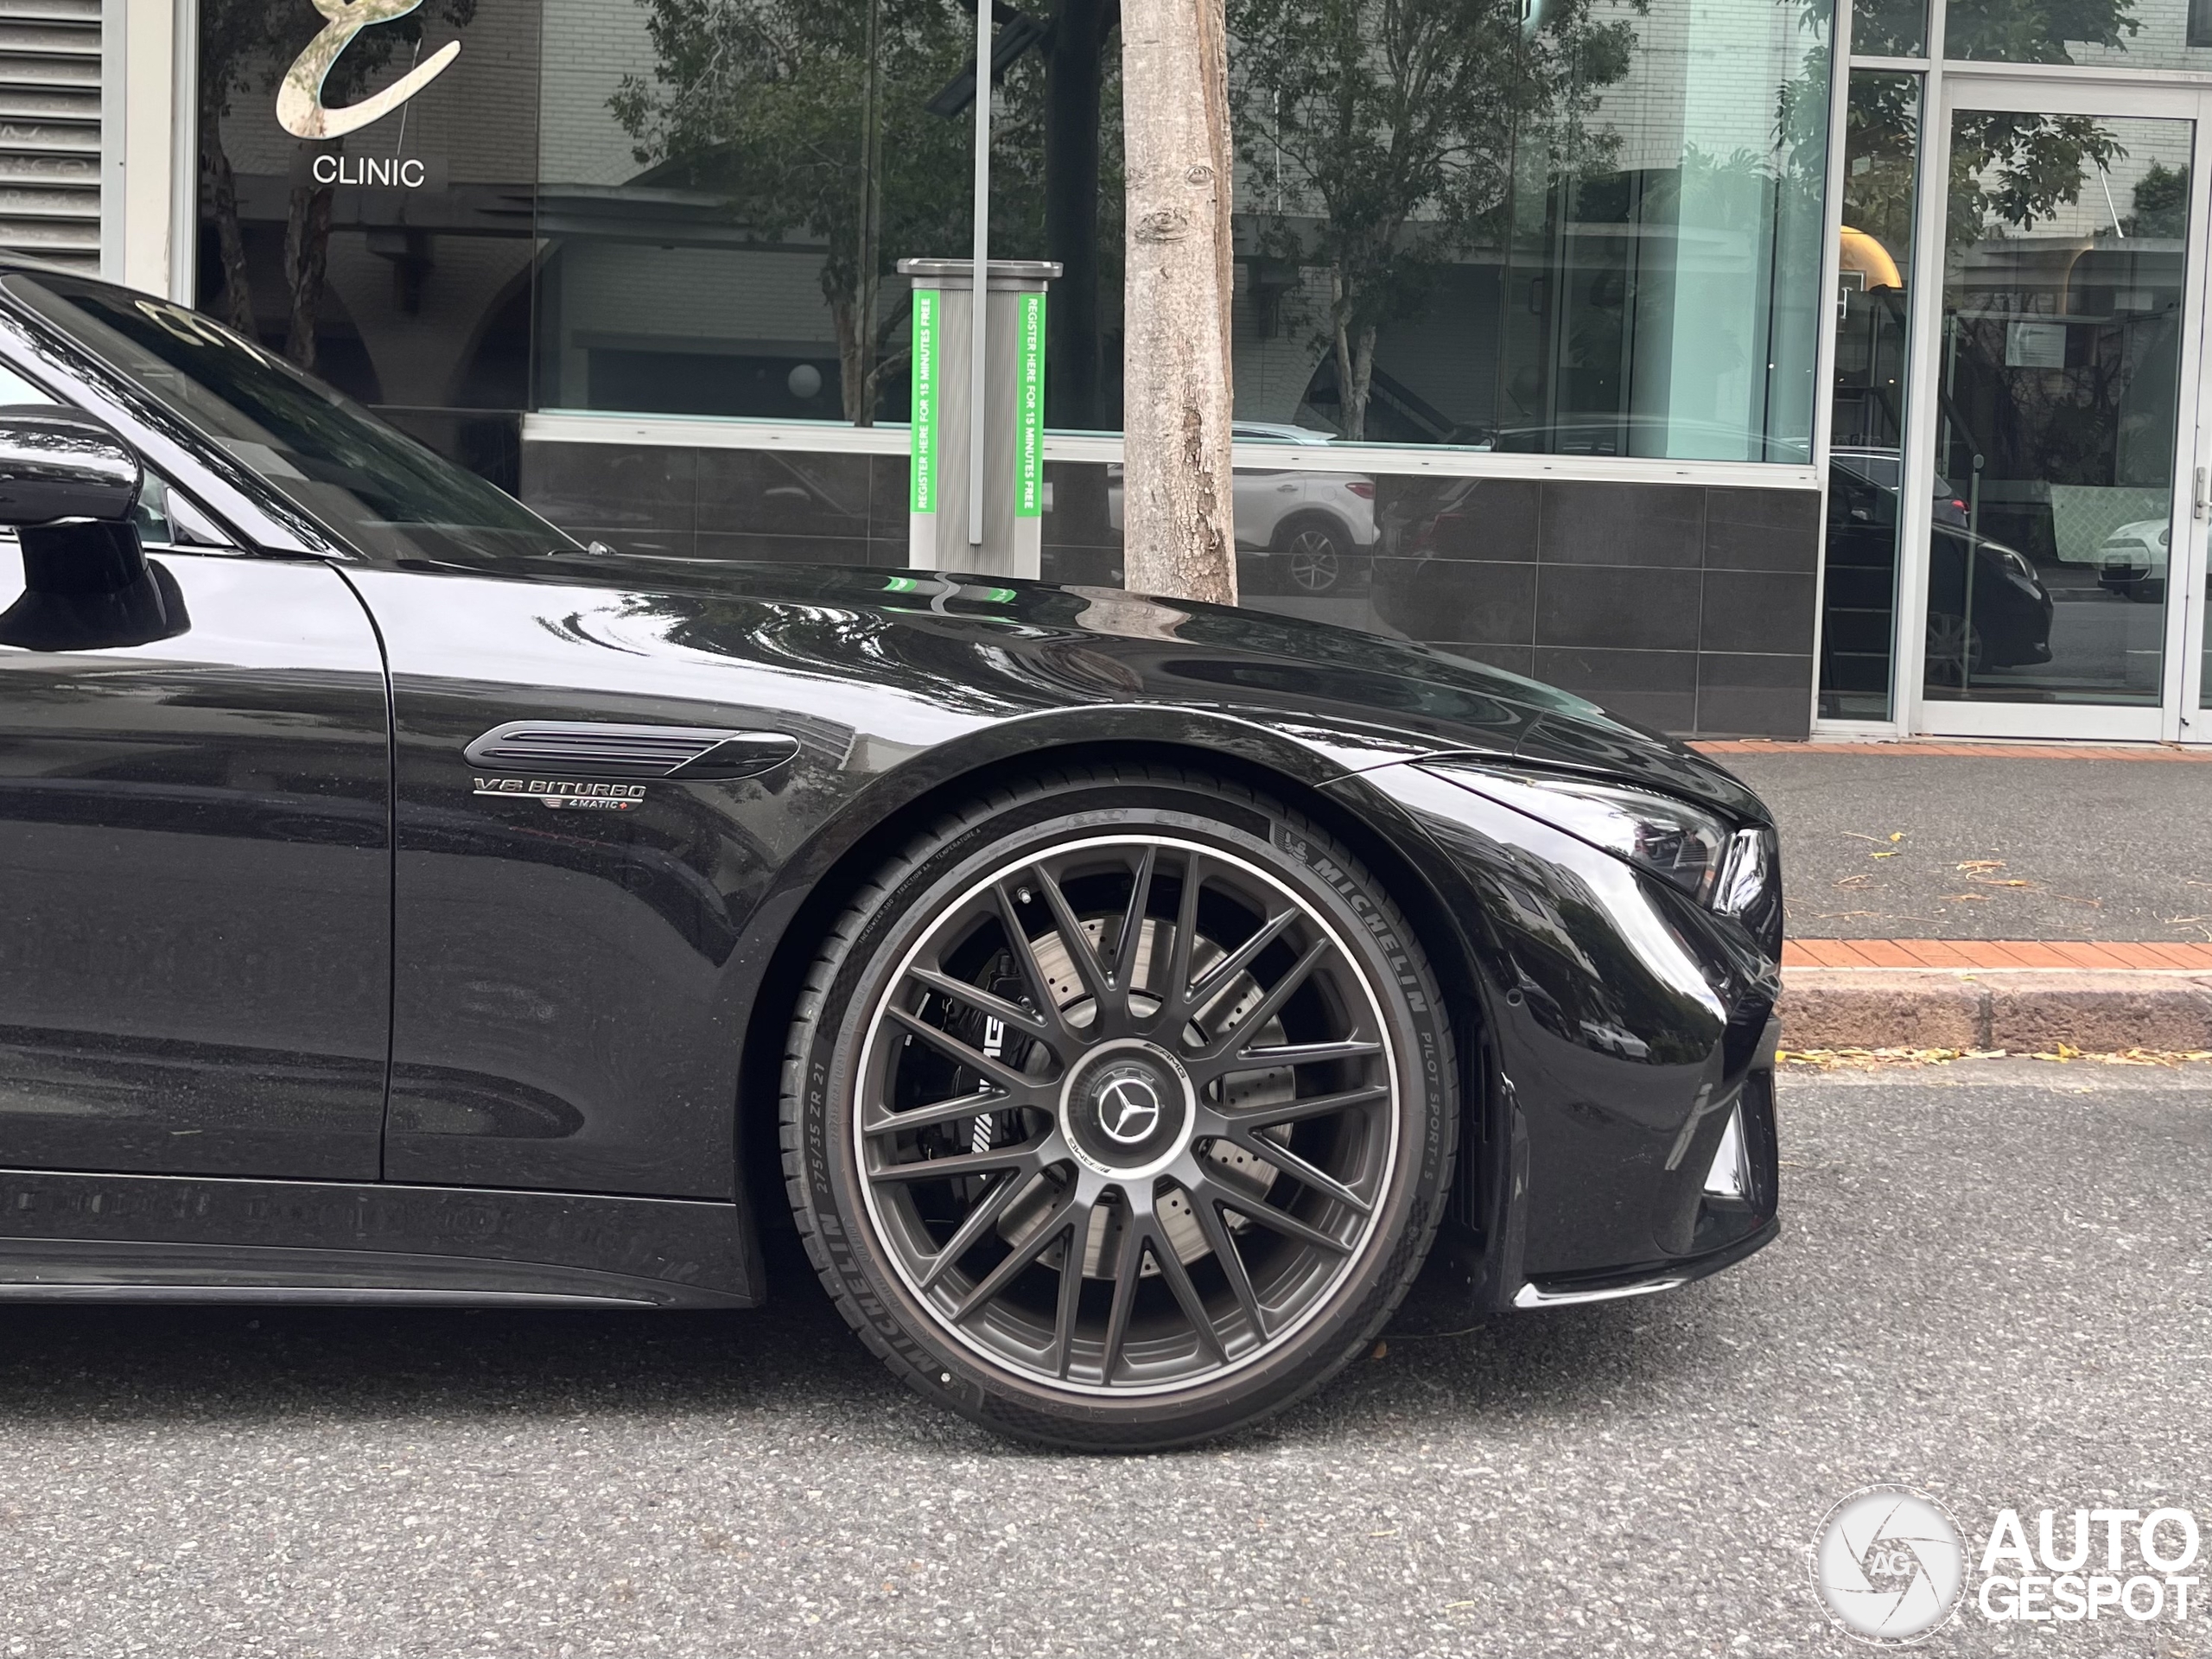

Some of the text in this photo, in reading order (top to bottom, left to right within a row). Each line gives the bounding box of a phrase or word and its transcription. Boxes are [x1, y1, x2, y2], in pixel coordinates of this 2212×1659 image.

[313, 155, 424, 188] CLINIC
[918, 298, 931, 509] REGISTER HERE FOR 15 MINUTES FREE
[1024, 298, 1039, 509] REGISTER HERE FOR 15 MINUTES FREE
[474, 778, 646, 797] V8 BITURBO
[935, 831, 975, 861] TEMPERATURE
[896, 863, 931, 895] TRACTION AA
[857, 909, 885, 944] TREADWEAR
[1313, 858, 1427, 1012] MICHELIN
[1421, 1032, 1439, 1086] PILOT
[810, 1062, 828, 1194] 275/35 ZR 21
[1428, 1092, 1440, 1157] SPORT
[1424, 1170, 1433, 1179] S
[818, 1213, 938, 1373] MICHELIN
